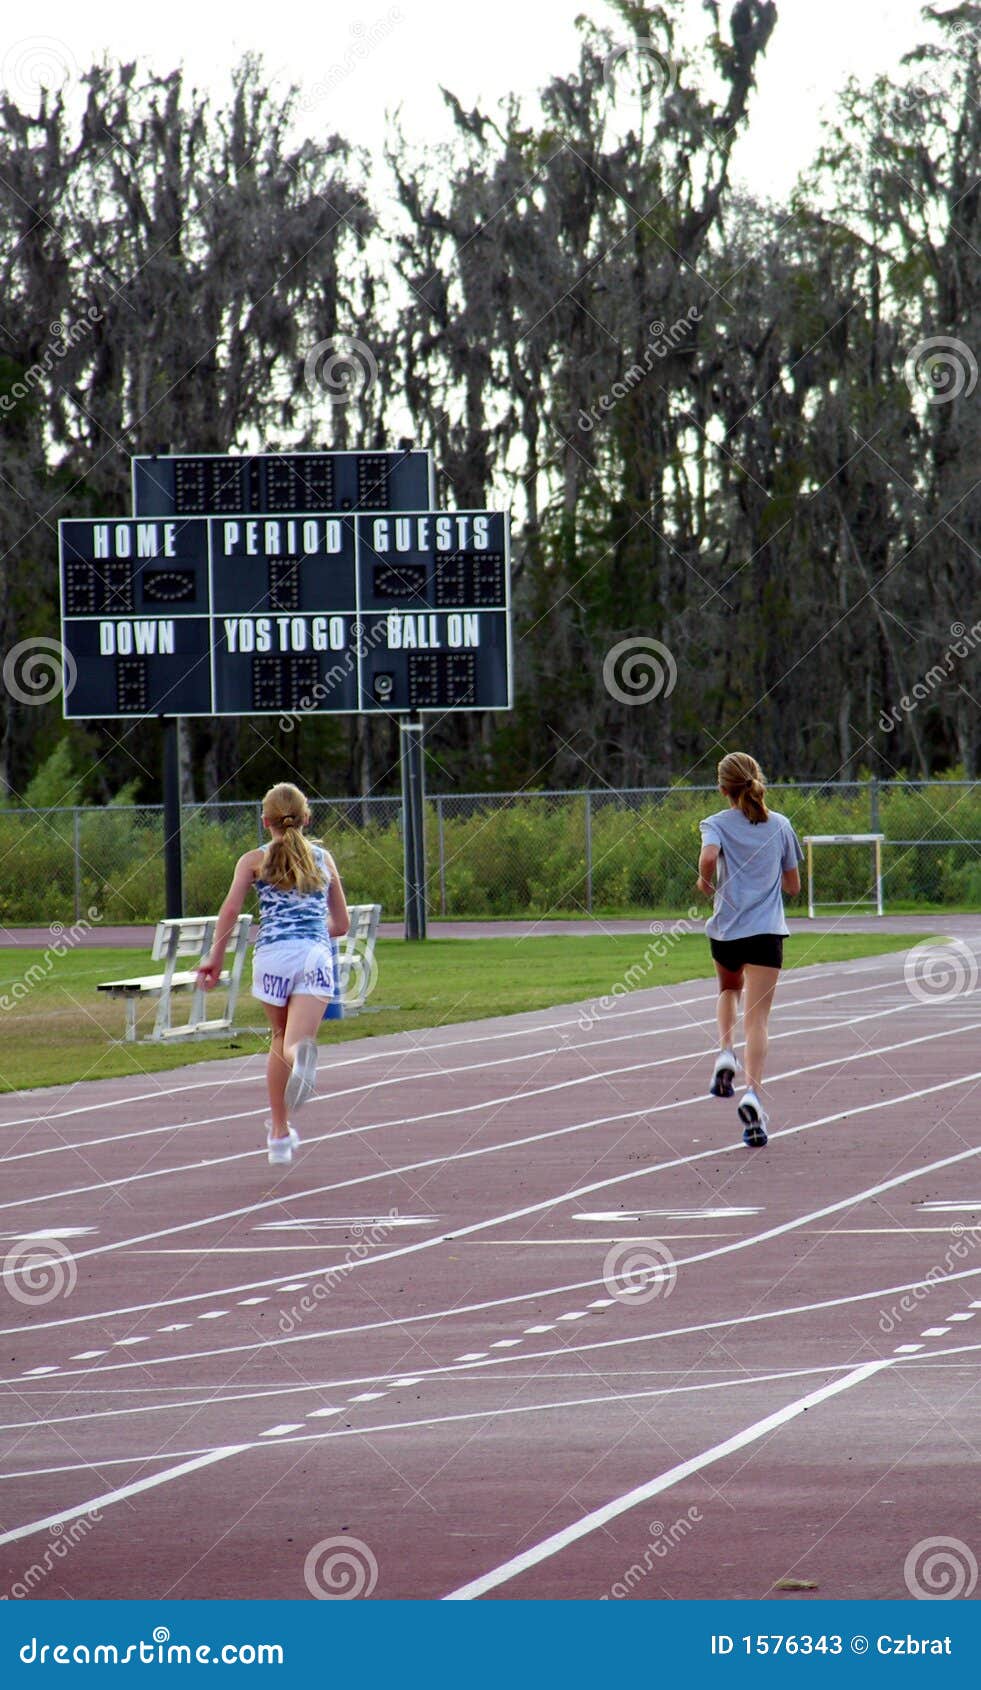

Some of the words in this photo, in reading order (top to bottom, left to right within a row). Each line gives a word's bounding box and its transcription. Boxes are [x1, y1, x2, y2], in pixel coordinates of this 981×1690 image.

[94, 524, 176, 558] HOME
[223, 519, 342, 555] PERIOD
[373, 516, 488, 553] GUESTS
[100, 620, 174, 655] DOWN
[224, 618, 271, 653] YDS
[277, 617, 307, 652] TO
[312, 616, 345, 651] GO
[387, 614, 440, 649] BALL
[447, 614, 480, 648] ON
[263, 973, 290, 999] GYM
